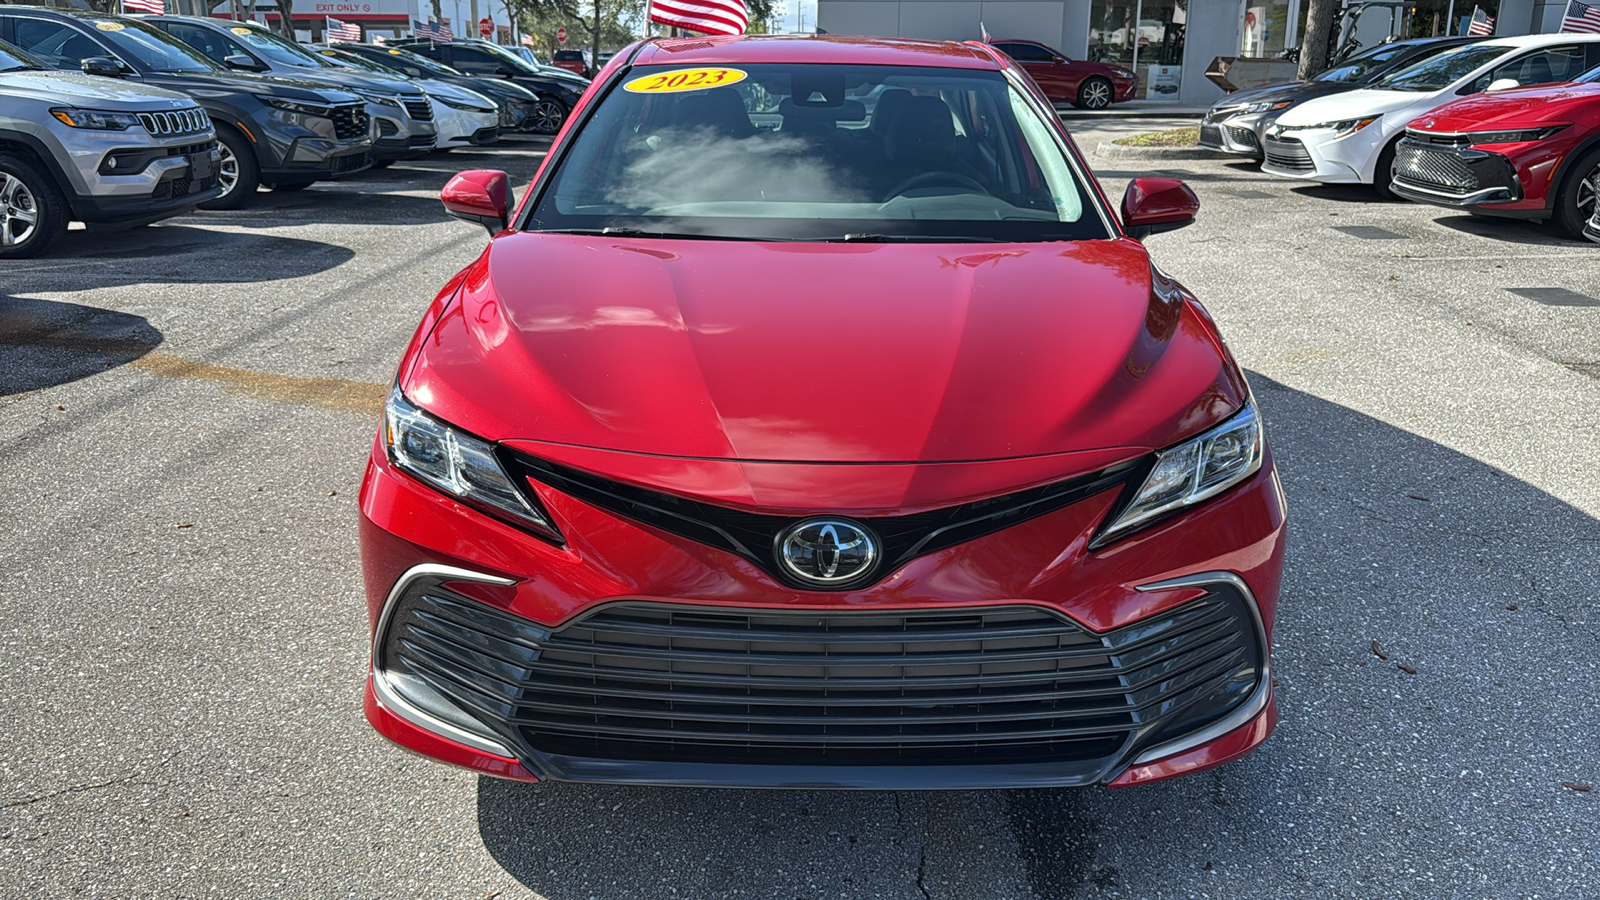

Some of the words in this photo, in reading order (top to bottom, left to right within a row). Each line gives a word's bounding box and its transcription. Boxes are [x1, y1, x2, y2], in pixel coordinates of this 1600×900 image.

[316, 4, 334, 12] EXIT
[337, 4, 360, 12] ONLY
[645, 71, 728, 90] 2023
